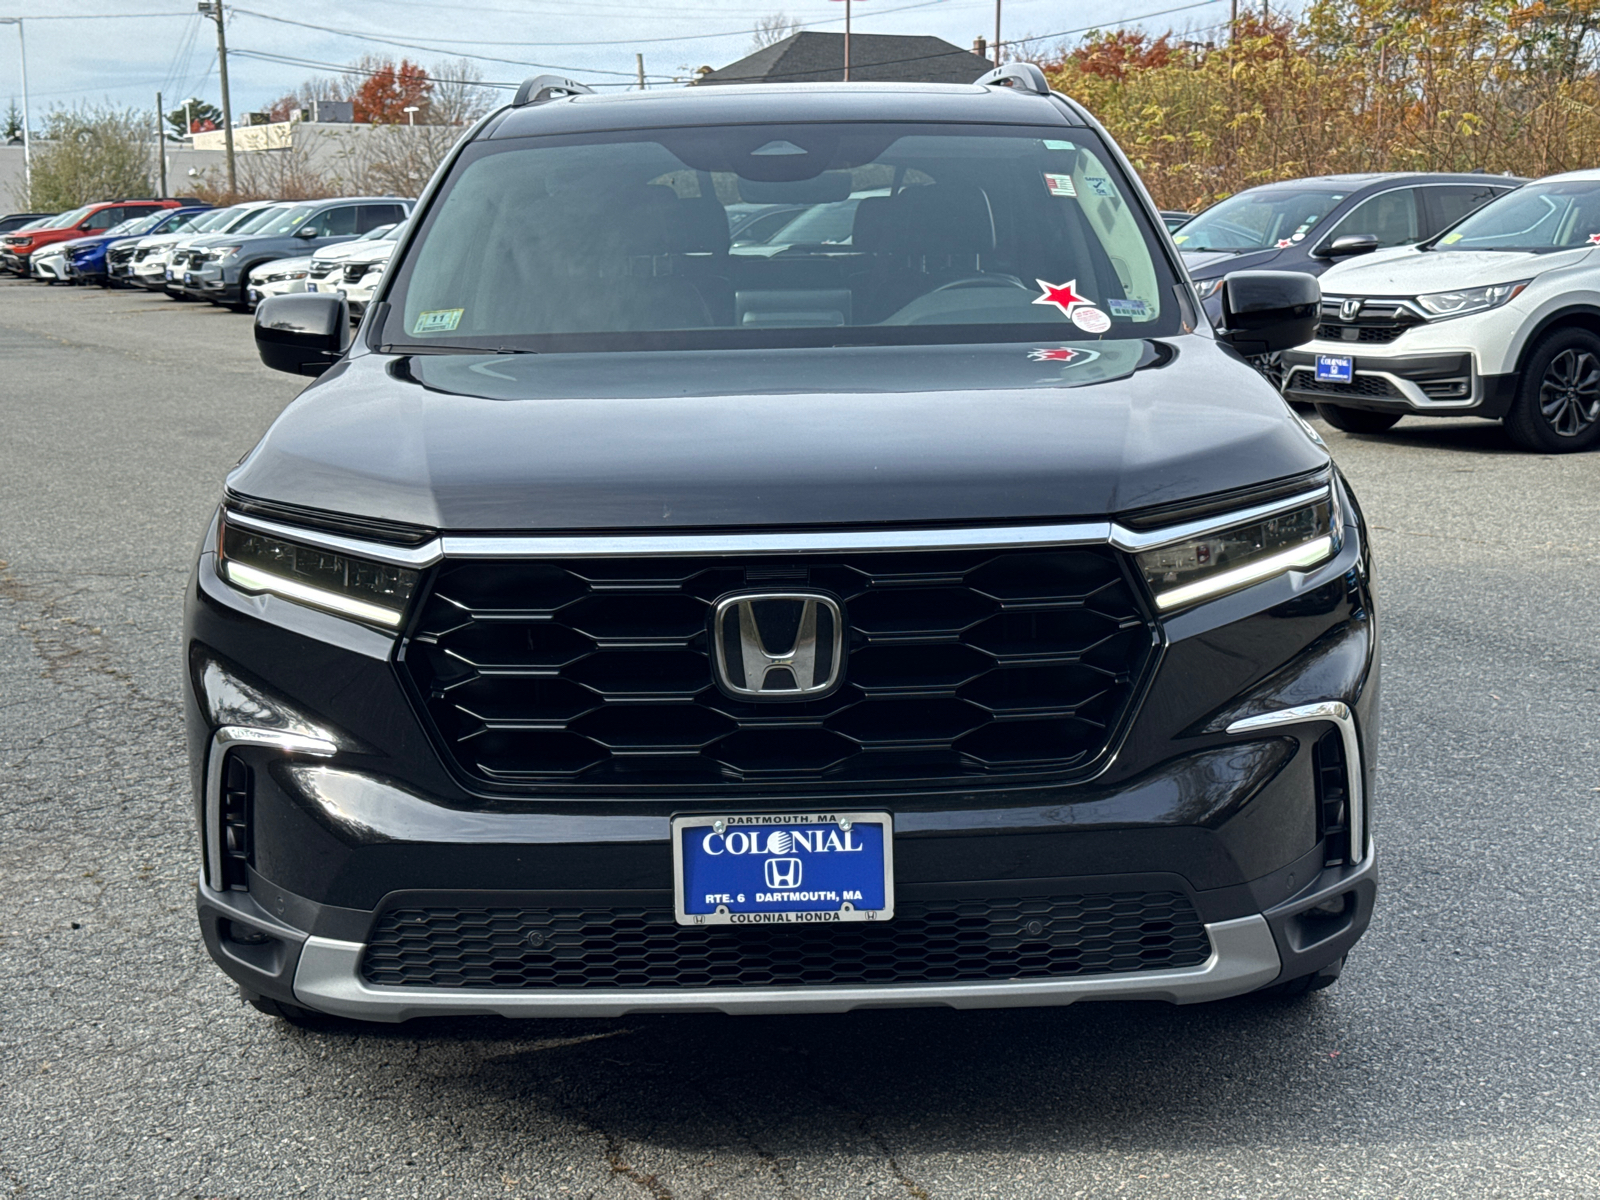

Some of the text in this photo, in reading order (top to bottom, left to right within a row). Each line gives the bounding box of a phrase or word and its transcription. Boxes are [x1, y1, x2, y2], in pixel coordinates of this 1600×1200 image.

[432, 314, 445, 323] 11
[817, 814, 837, 823] MA
[702, 829, 863, 856] COLONIAL
[705, 890, 863, 904] RTE. 6 DARTMOUTH, MA
[729, 911, 841, 923] COLONIAL HONDA
